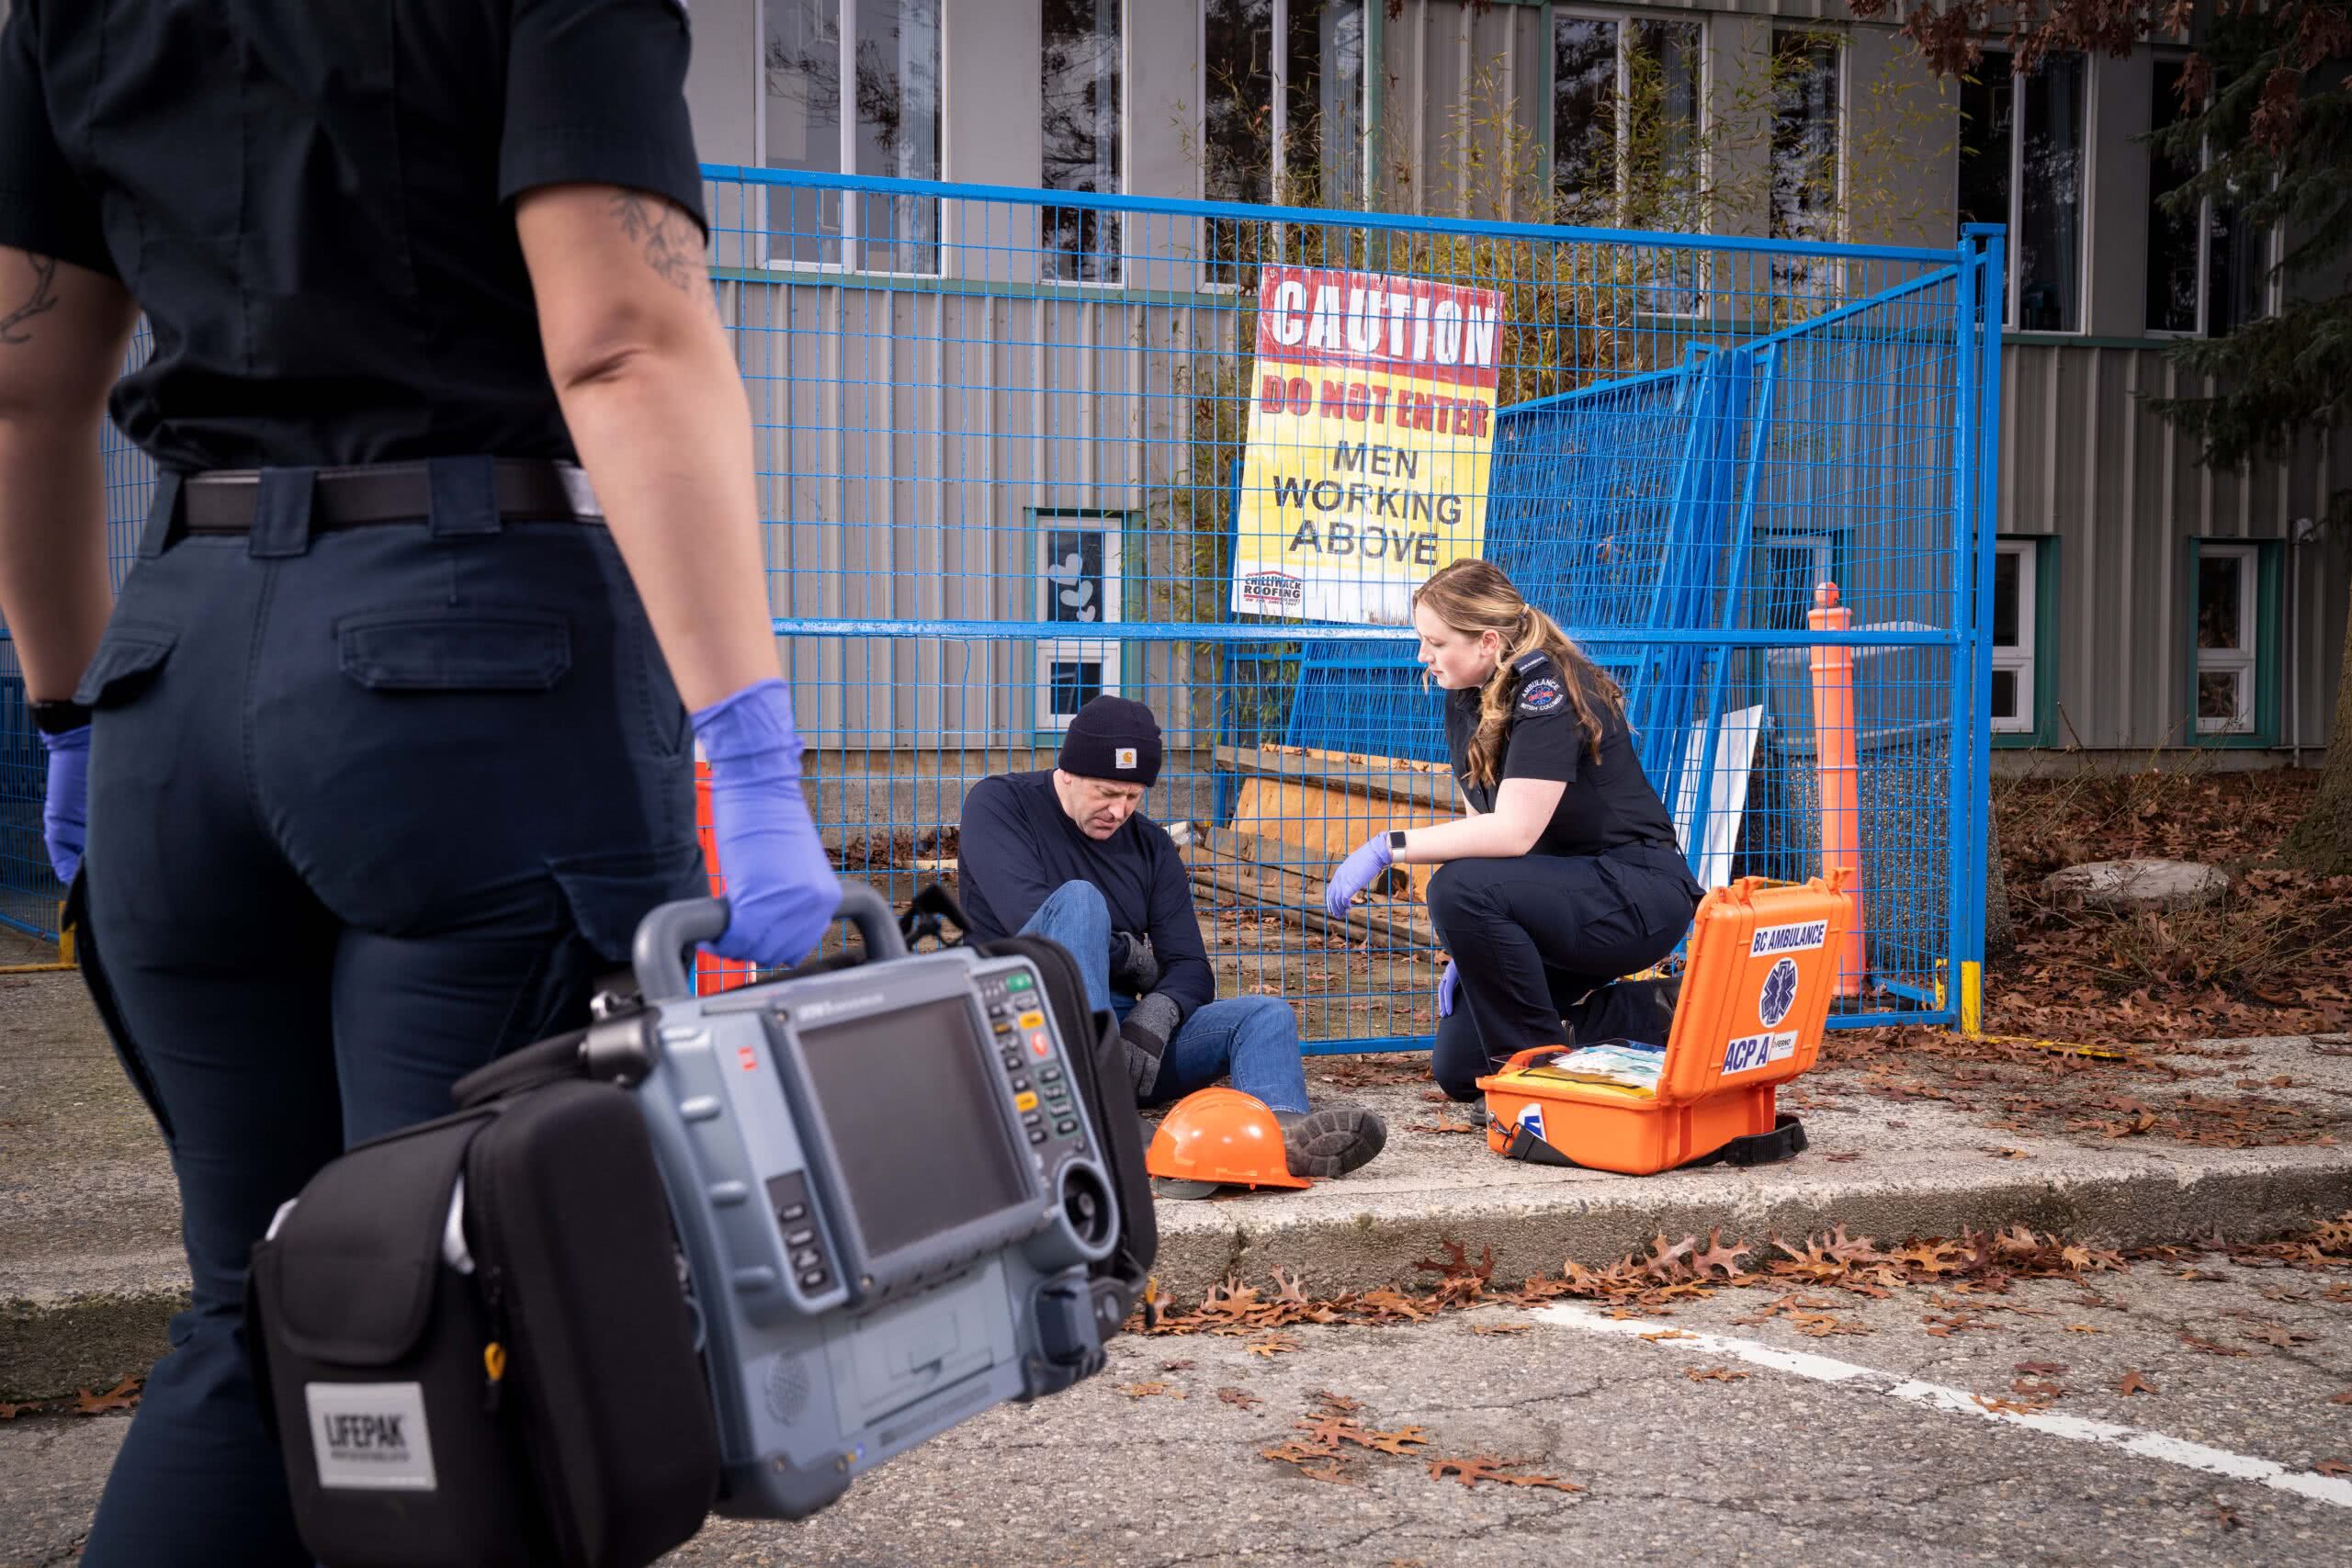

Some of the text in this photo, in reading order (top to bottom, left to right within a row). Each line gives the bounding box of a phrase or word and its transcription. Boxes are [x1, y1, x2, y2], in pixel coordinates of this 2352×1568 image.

[1272, 281, 1496, 369] CAUTION
[1261, 375, 1489, 439] DO NOT ENTER
[1332, 440, 1418, 480] MEN
[1272, 476, 1462, 525] WORKING
[1288, 519, 1439, 566] ABOVE
[1244, 585, 1301, 599] ROOFING
[1520, 694, 1564, 712] BRITISH COLUMBIA
[1521, 679, 1560, 698] AMBULANCE
[1753, 924, 1825, 953] BC AMBULANCE
[1722, 1036, 1770, 1073] ACP A
[324, 1414, 406, 1448] LIFEPAK
